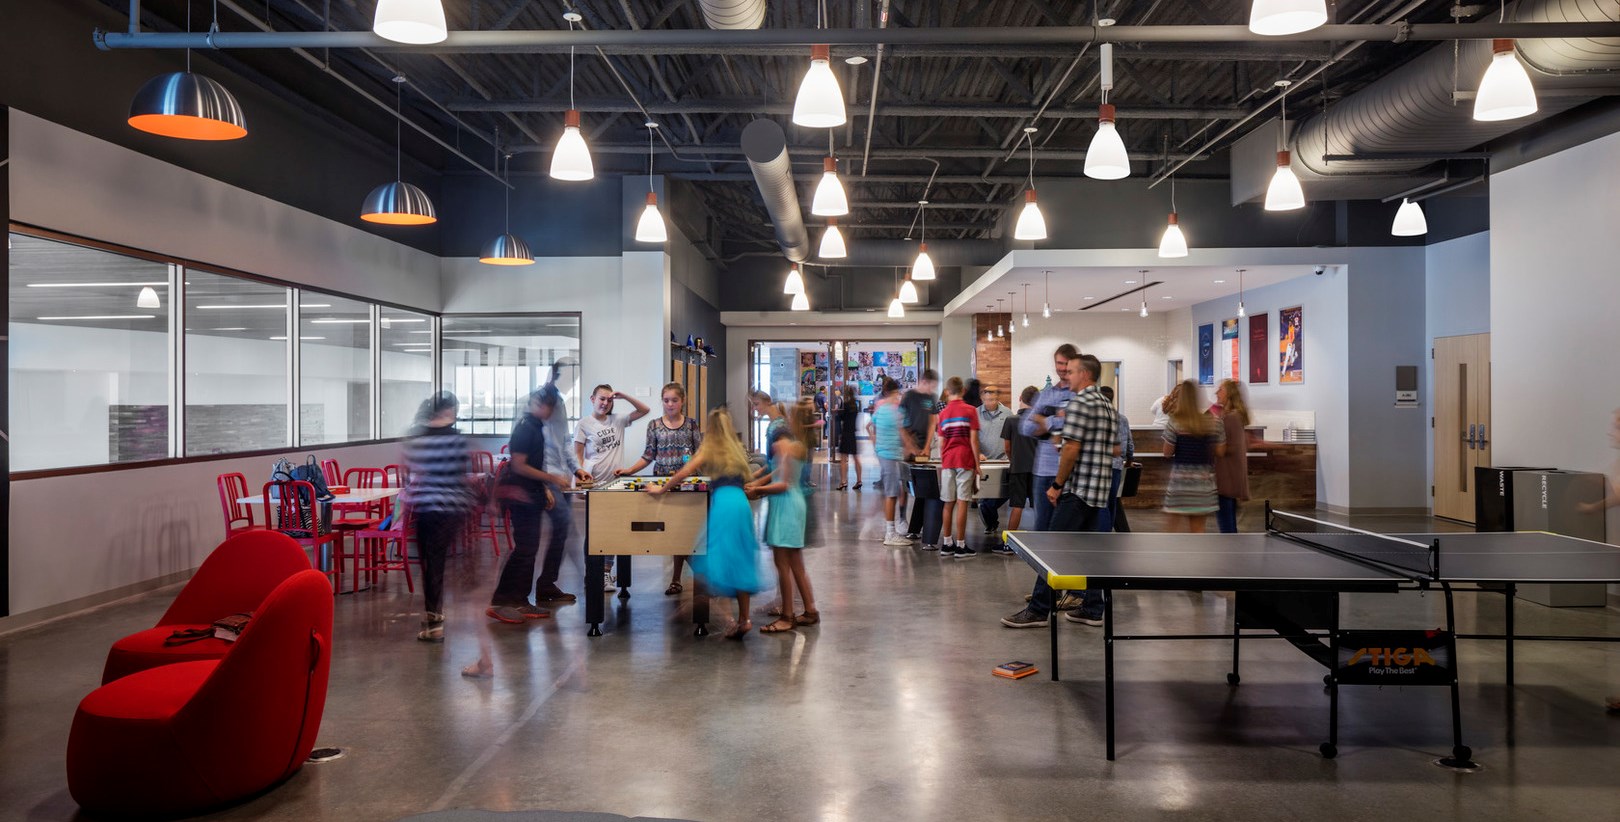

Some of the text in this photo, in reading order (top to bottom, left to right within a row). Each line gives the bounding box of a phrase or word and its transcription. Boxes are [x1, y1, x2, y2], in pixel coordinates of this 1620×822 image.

[602, 435, 615, 444] BUT
[1347, 647, 1436, 666] STIGA
[1368, 667, 1384, 676] Play
[1385, 667, 1398, 675] The
